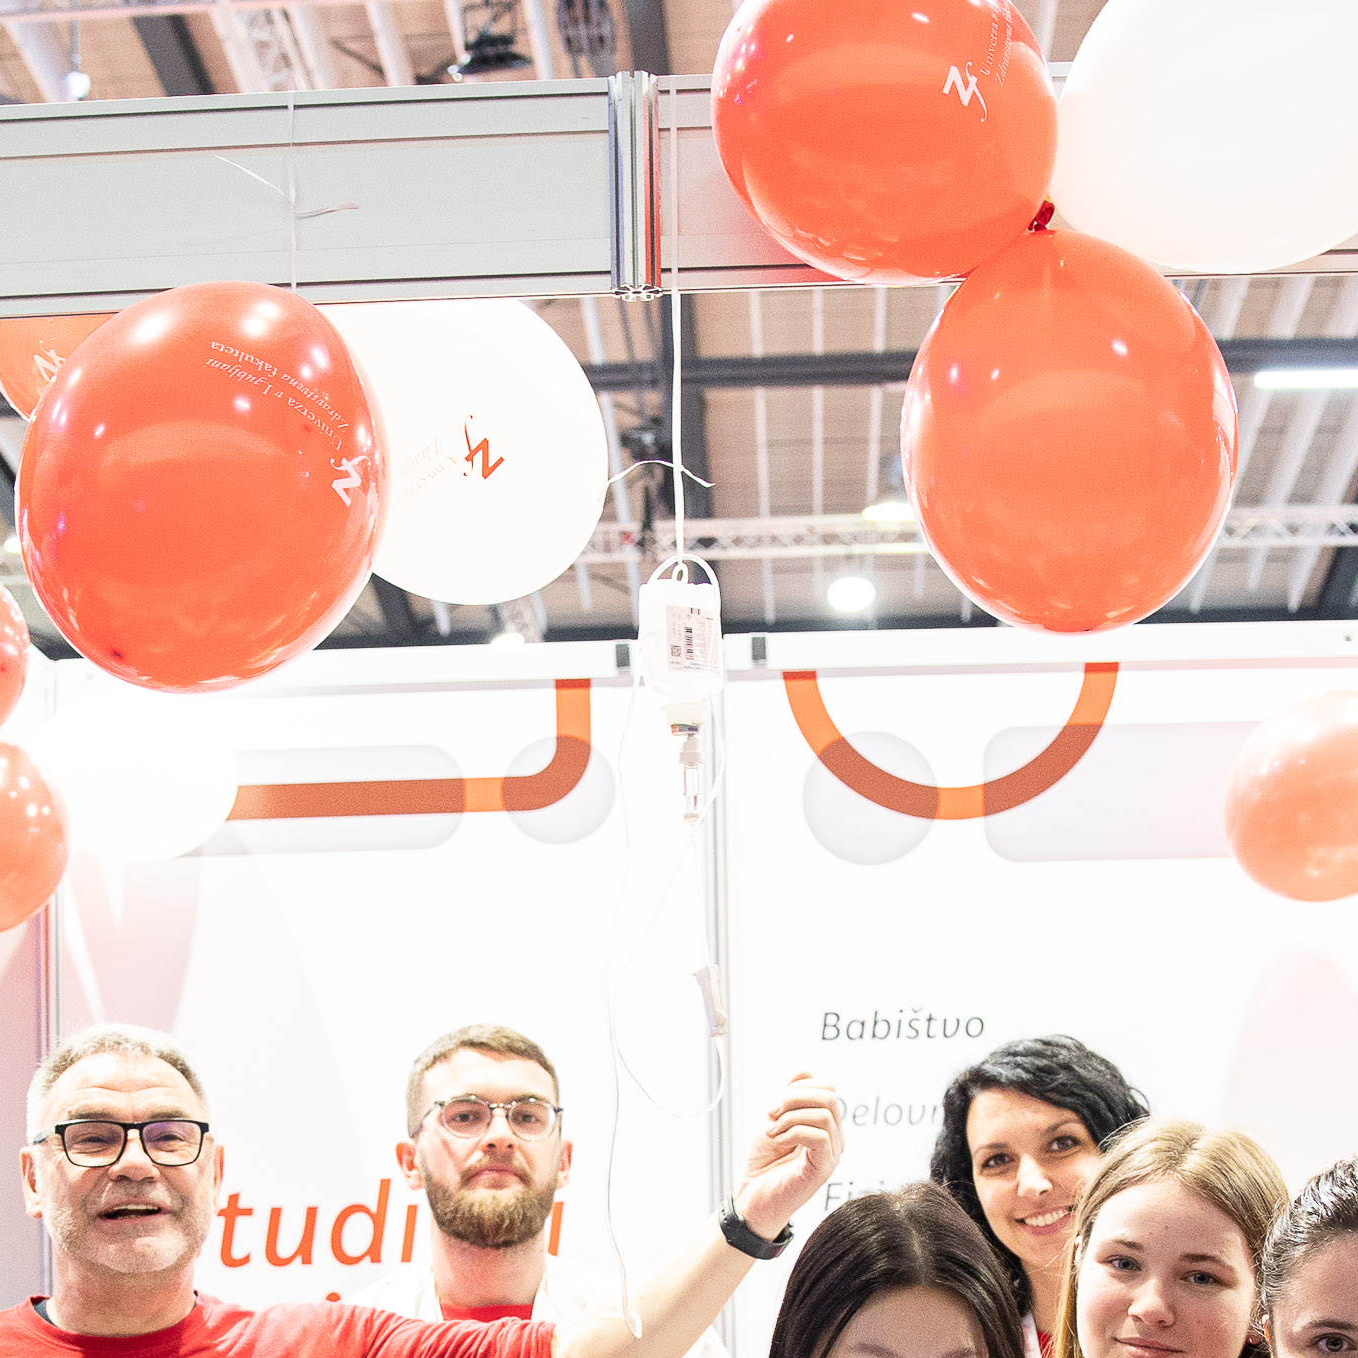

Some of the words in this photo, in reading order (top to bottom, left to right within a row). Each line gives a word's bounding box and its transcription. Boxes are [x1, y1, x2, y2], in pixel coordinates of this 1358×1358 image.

[203, 357, 274, 396] Ljubljani
[210, 341, 278, 377] fakulteta
[281, 374, 349, 433] Zdravstvena
[287, 396, 342, 451] Univerza
[821, 1007, 986, 1042] Babištvo
